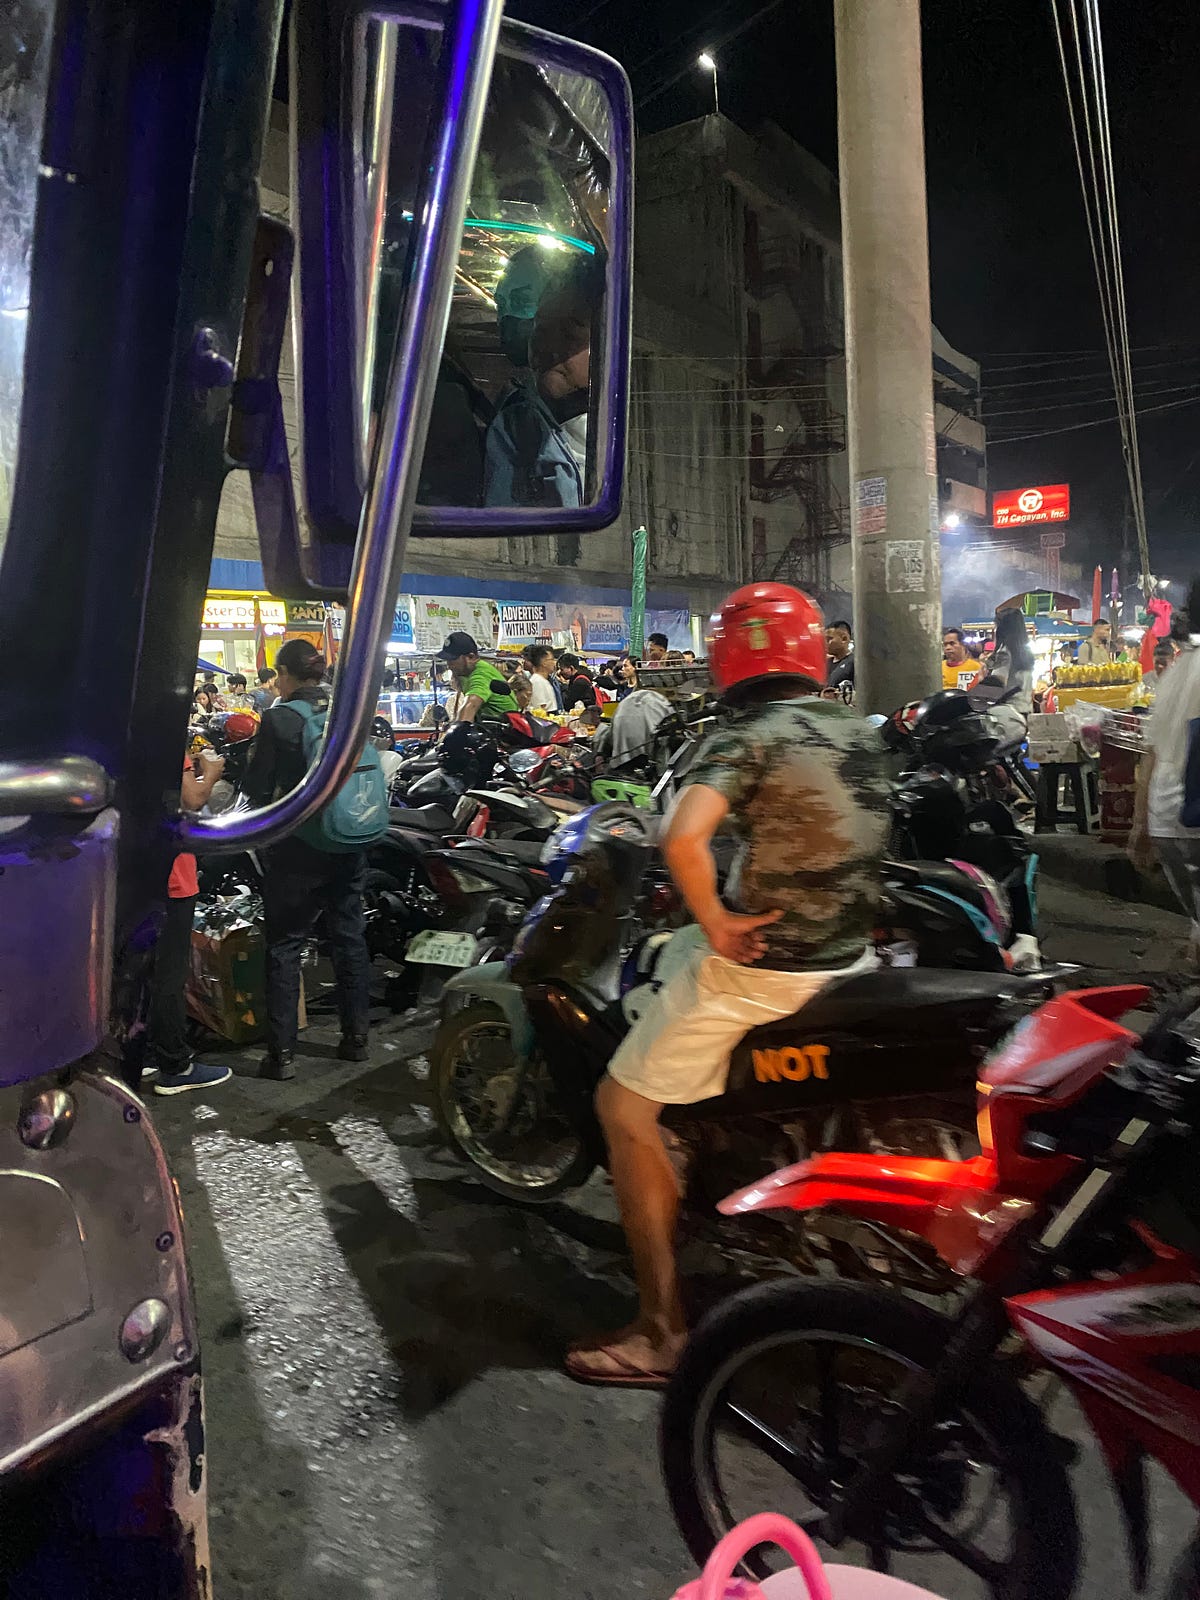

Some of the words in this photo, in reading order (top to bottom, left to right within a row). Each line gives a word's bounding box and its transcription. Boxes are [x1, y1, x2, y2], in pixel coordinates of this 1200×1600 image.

[997, 515, 1009, 524] TH
[1051, 509, 1066, 519] Inc.
[206, 605, 234, 617] ster
[502, 606, 544, 621] ADVERTISE
[505, 622, 526, 636] WITH
[526, 621, 539, 635] US!
[752, 1044, 831, 1083] NOT
